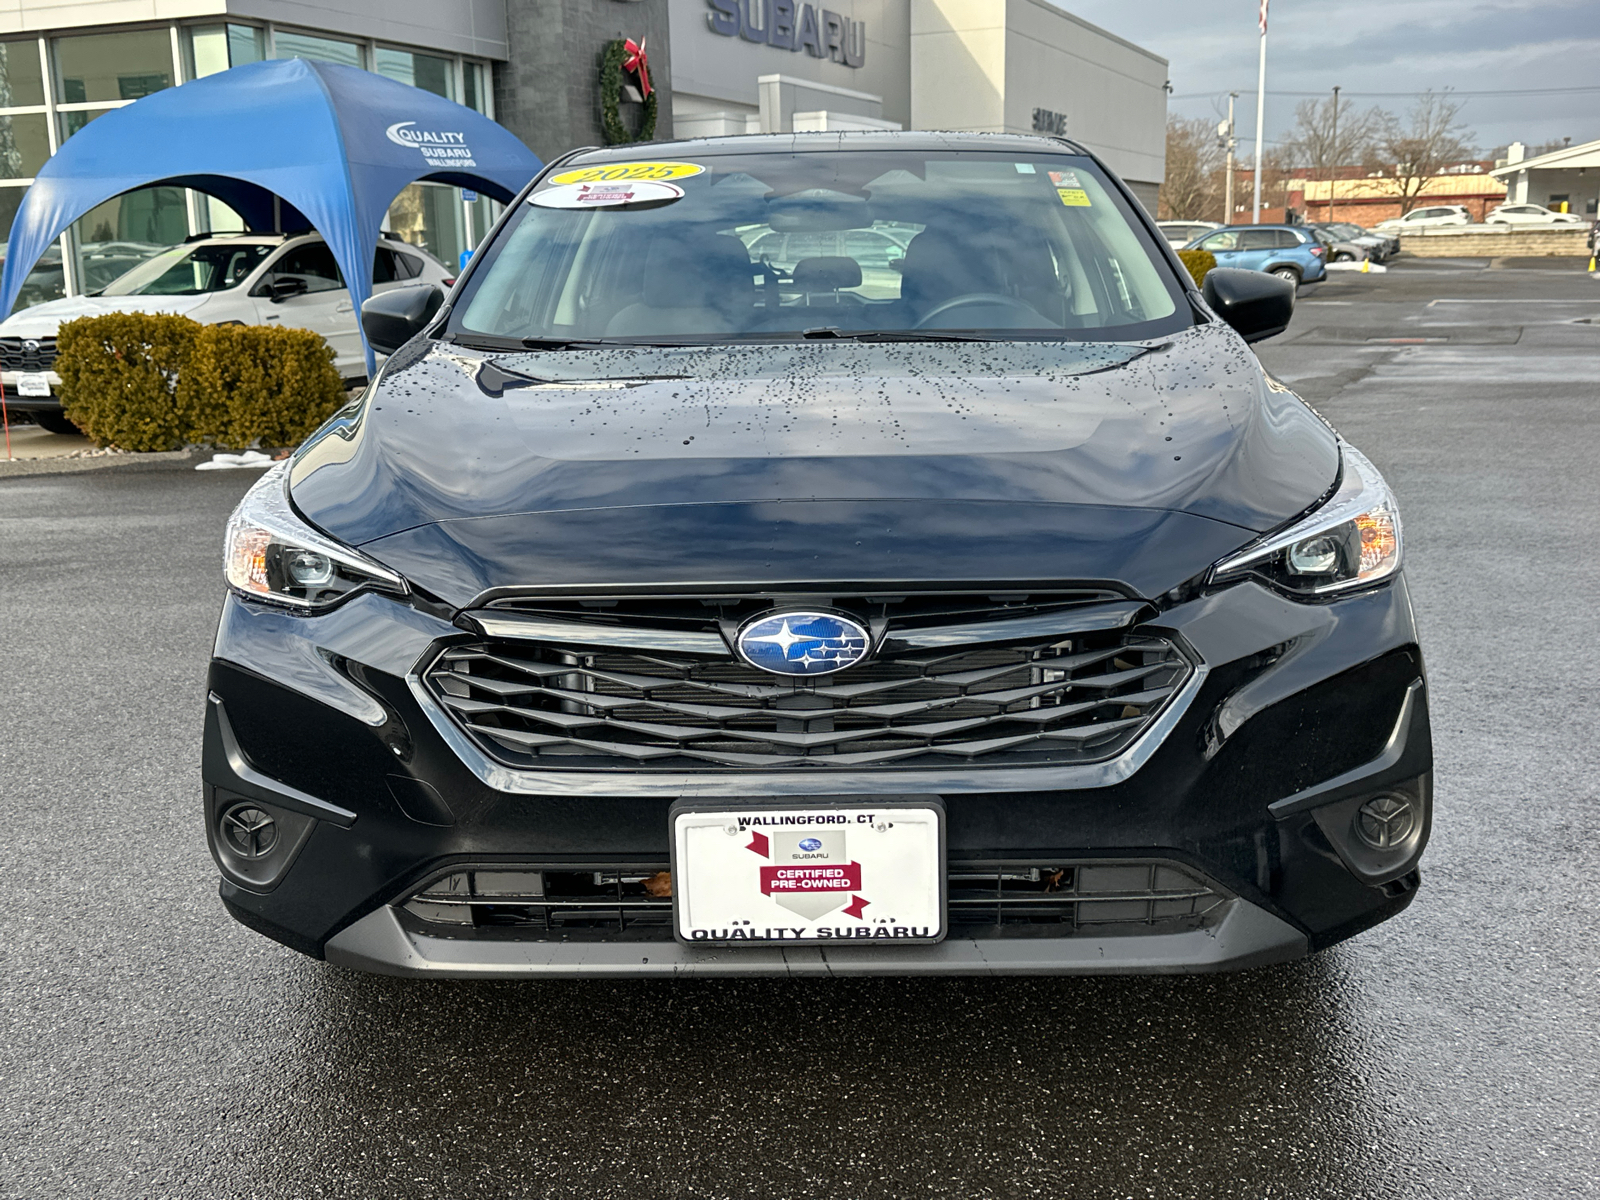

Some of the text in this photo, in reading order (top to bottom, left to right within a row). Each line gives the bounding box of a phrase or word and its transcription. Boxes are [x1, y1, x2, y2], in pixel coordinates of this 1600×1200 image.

[706, 0, 866, 69] SUBARU
[398, 129, 464, 143] QUALITY
[420, 147, 472, 158] SUBARU
[426, 158, 477, 167] WALLINGFORD
[574, 165, 680, 183] 2025
[857, 814, 876, 824] CT
[792, 852, 829, 860] SUBARU
[776, 869, 844, 879] CERTIFIED
[771, 878, 851, 889] PRE-OWNED
[691, 926, 929, 940] QUALITY SUBARU
